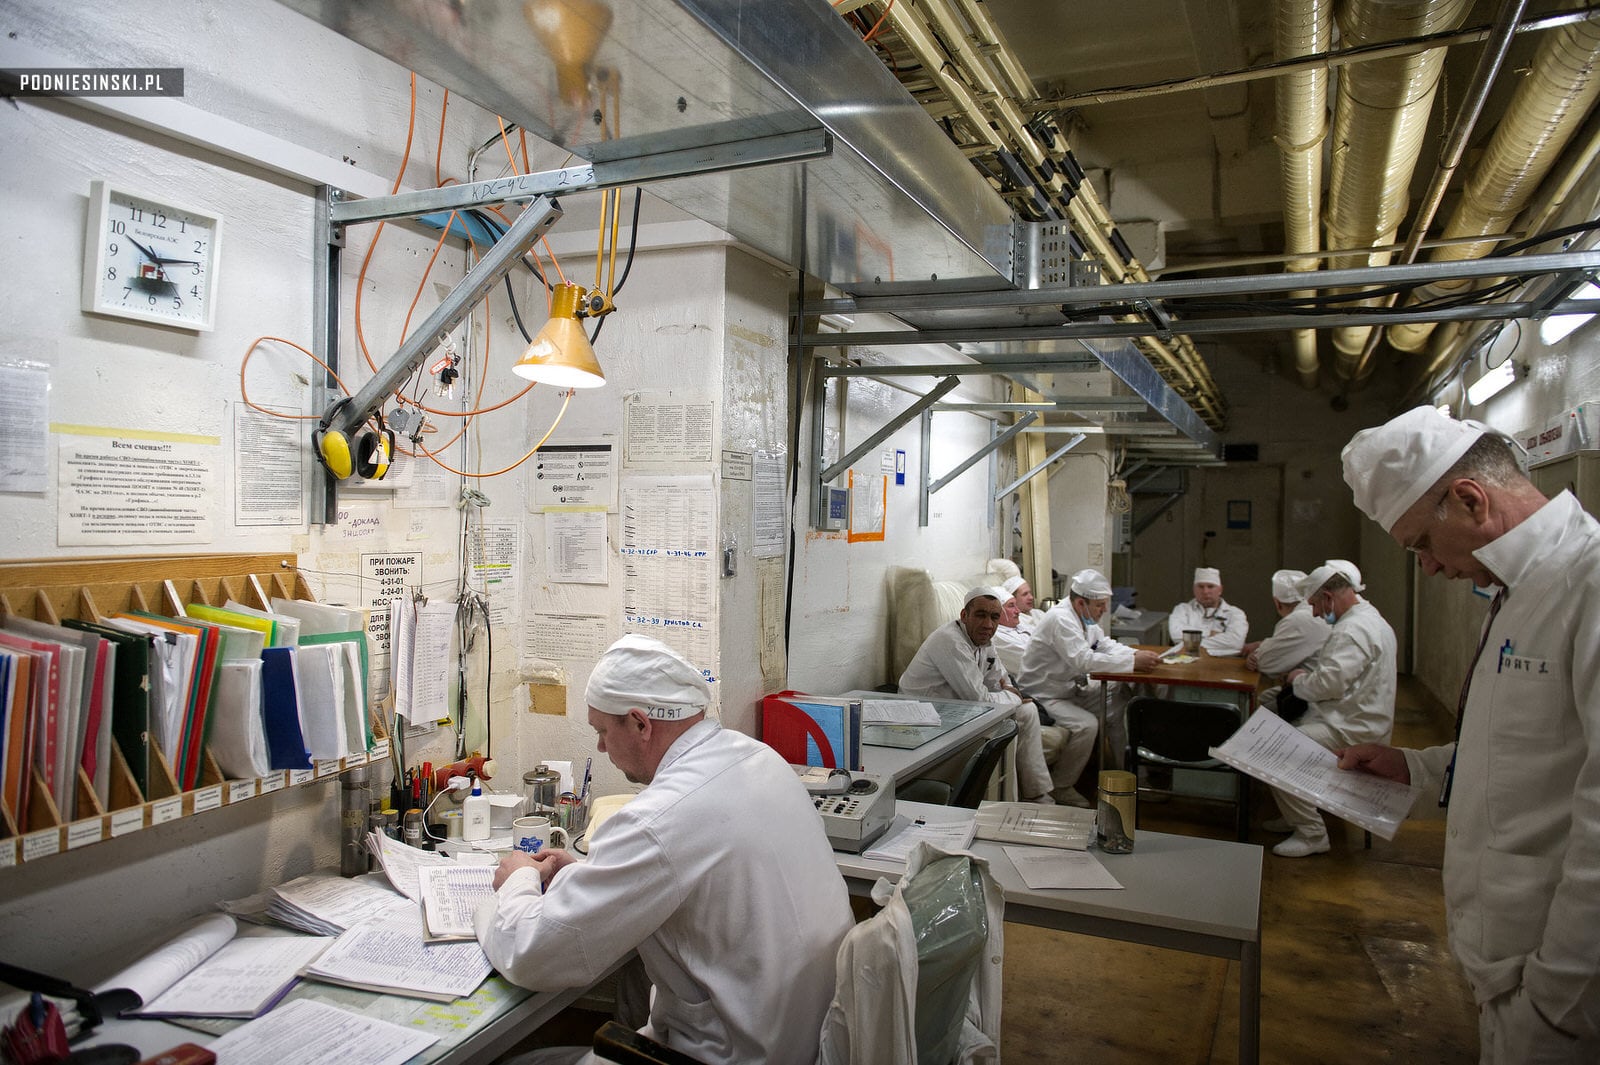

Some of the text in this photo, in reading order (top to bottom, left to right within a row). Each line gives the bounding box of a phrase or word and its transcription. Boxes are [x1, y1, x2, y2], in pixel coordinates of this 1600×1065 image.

[130, 206, 143, 223] 11
[151, 212, 167, 230] 12
[110, 219, 126, 235] 10
[179, 220, 186, 234] 1
[109, 244, 118, 256] 9
[194, 240, 203, 254] 2
[107, 266, 117, 280] 8
[192, 262, 200, 276] 3
[122, 286, 132, 301] 7
[190, 284, 200, 298] 4
[148, 292, 157, 306] 6
[172, 296, 182, 310] 5
[112, 440, 132, 449] Всем
[370, 557, 415, 566] ПРИ ПОЖАРЕ
[374, 568, 410, 576] ЗВОНИТЬ:
[380, 578, 404, 586] 4-31-01
[380, 588, 404, 596] 4-24-01
[370, 614, 384, 623] ДЛЯ
[626, 616, 660, 625] 4-32-39
